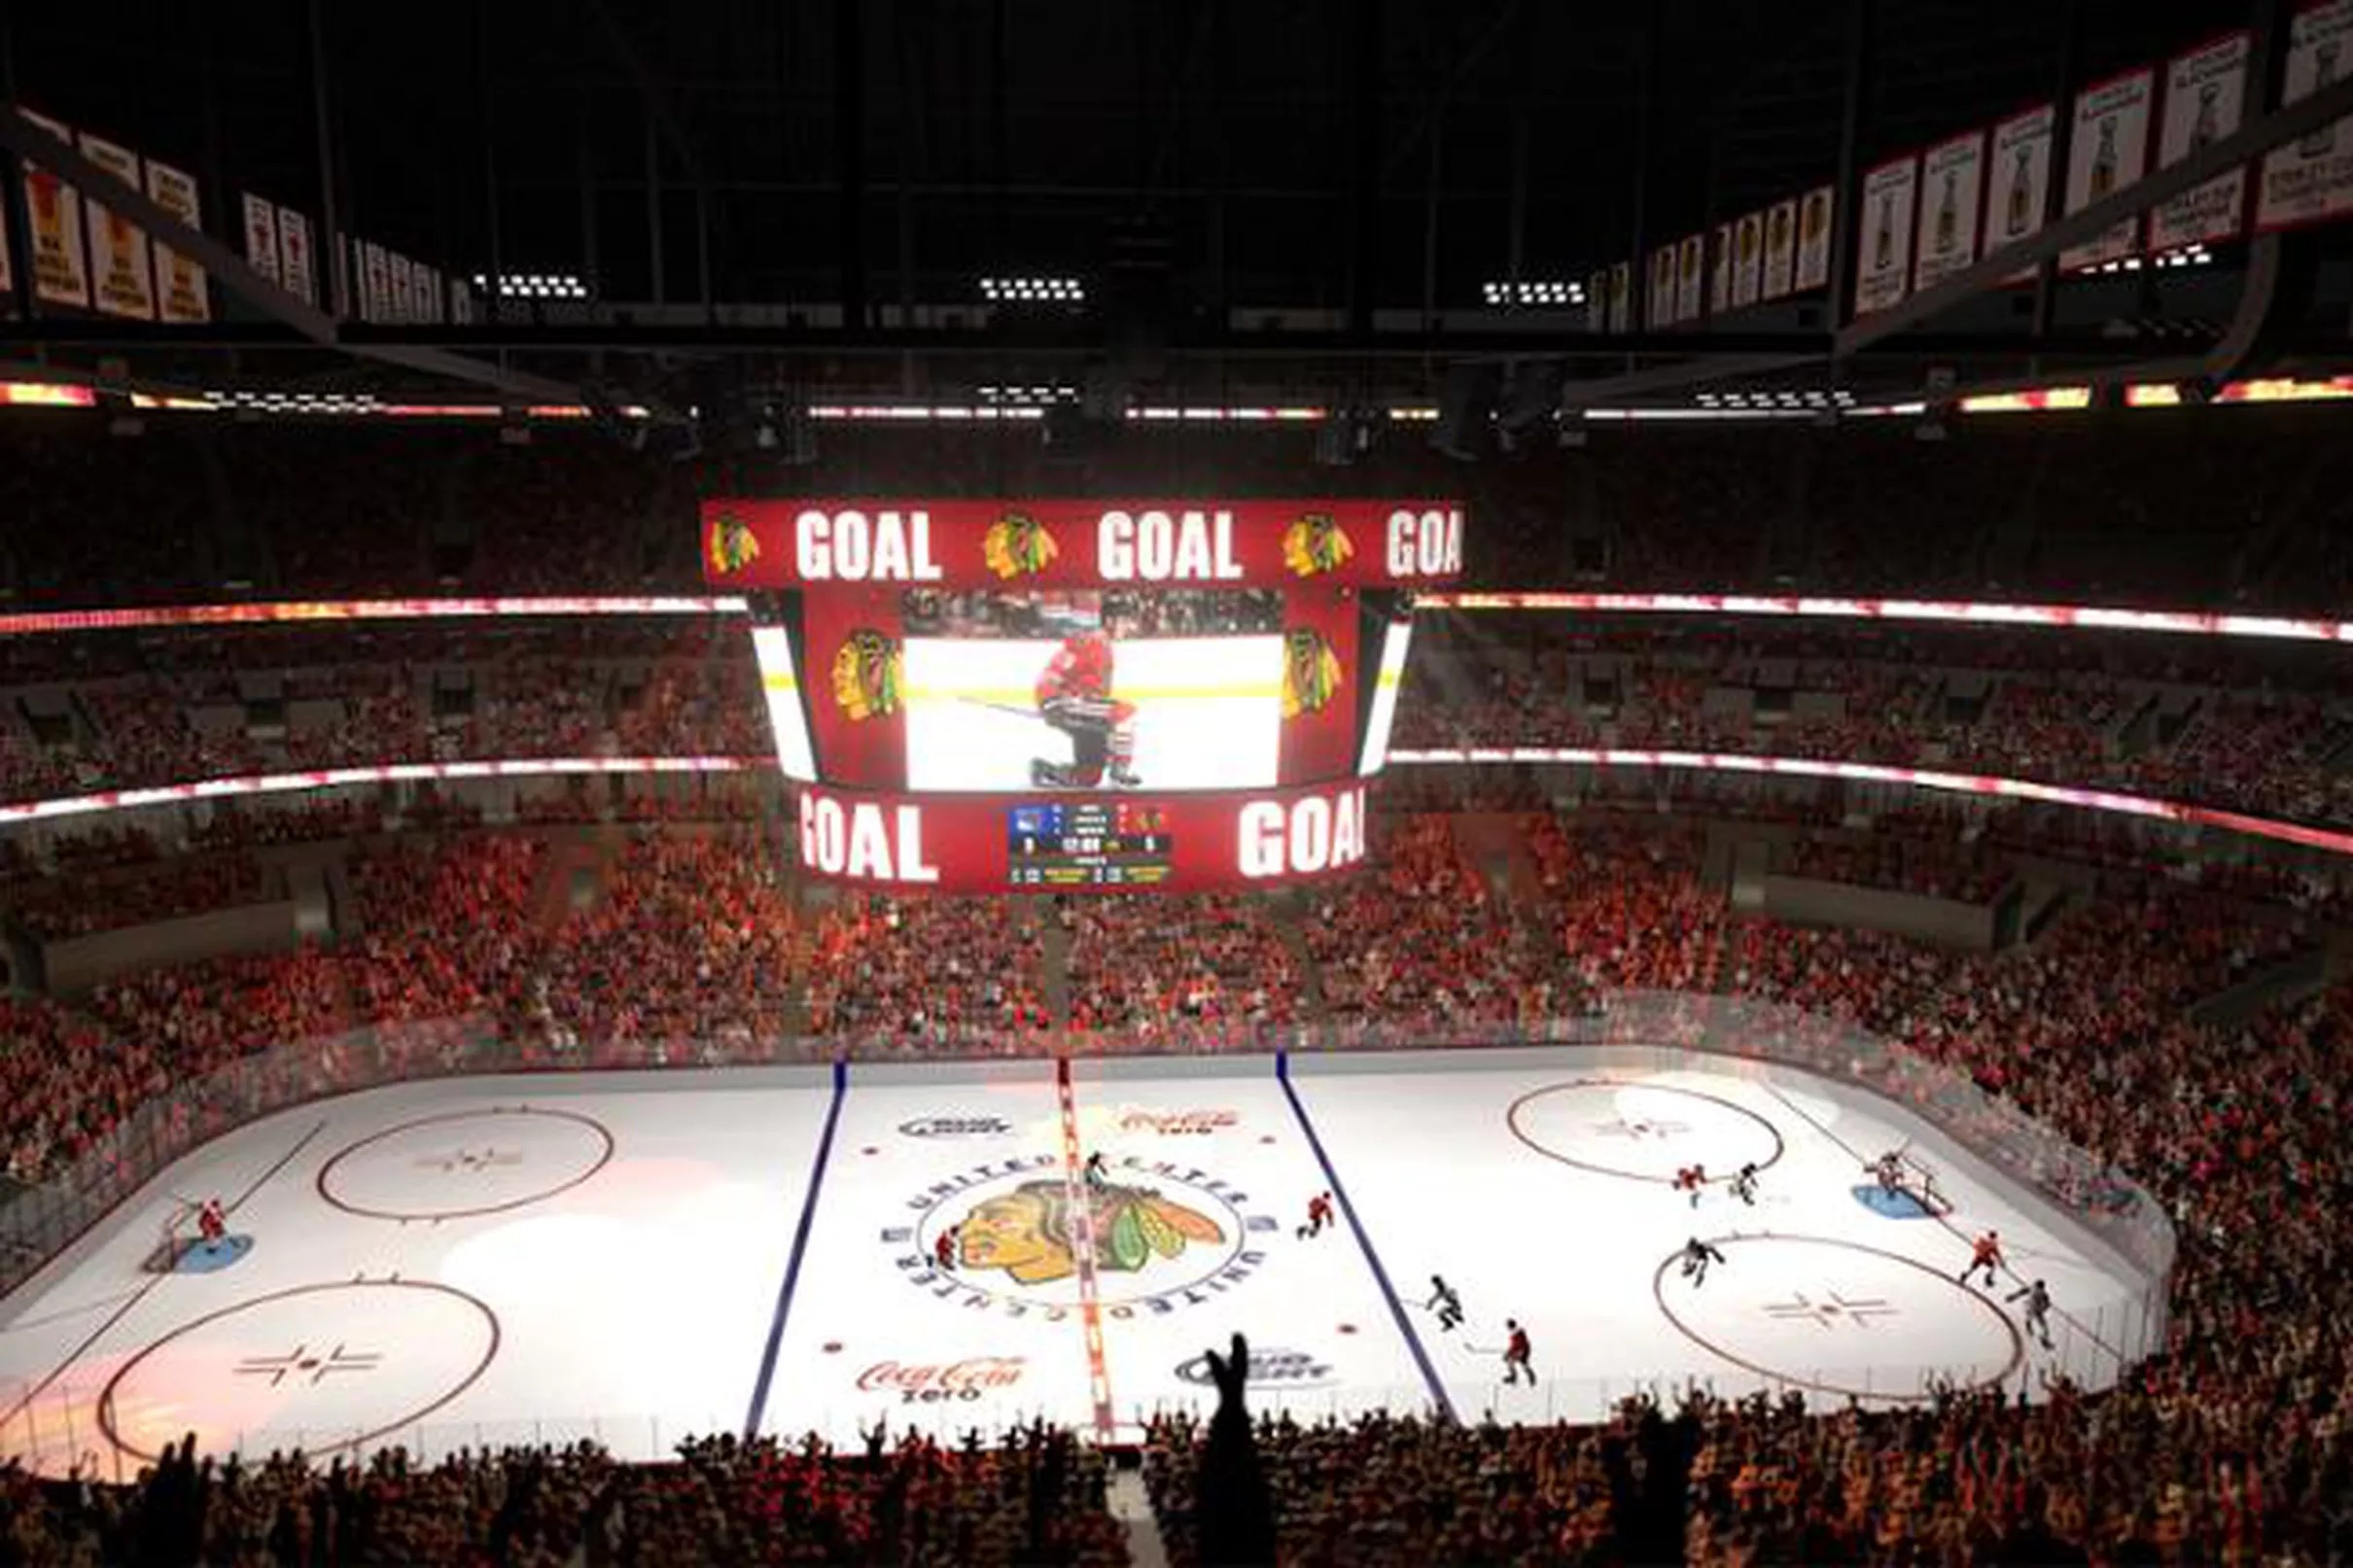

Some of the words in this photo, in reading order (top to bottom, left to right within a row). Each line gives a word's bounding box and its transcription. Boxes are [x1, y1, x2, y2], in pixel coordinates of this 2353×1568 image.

[795, 510, 943, 581] GOAL
[1097, 510, 1245, 581] GOAL
[906, 1153, 1057, 1211] UNITED
[1109, 1249, 1268, 1320] UNITED
